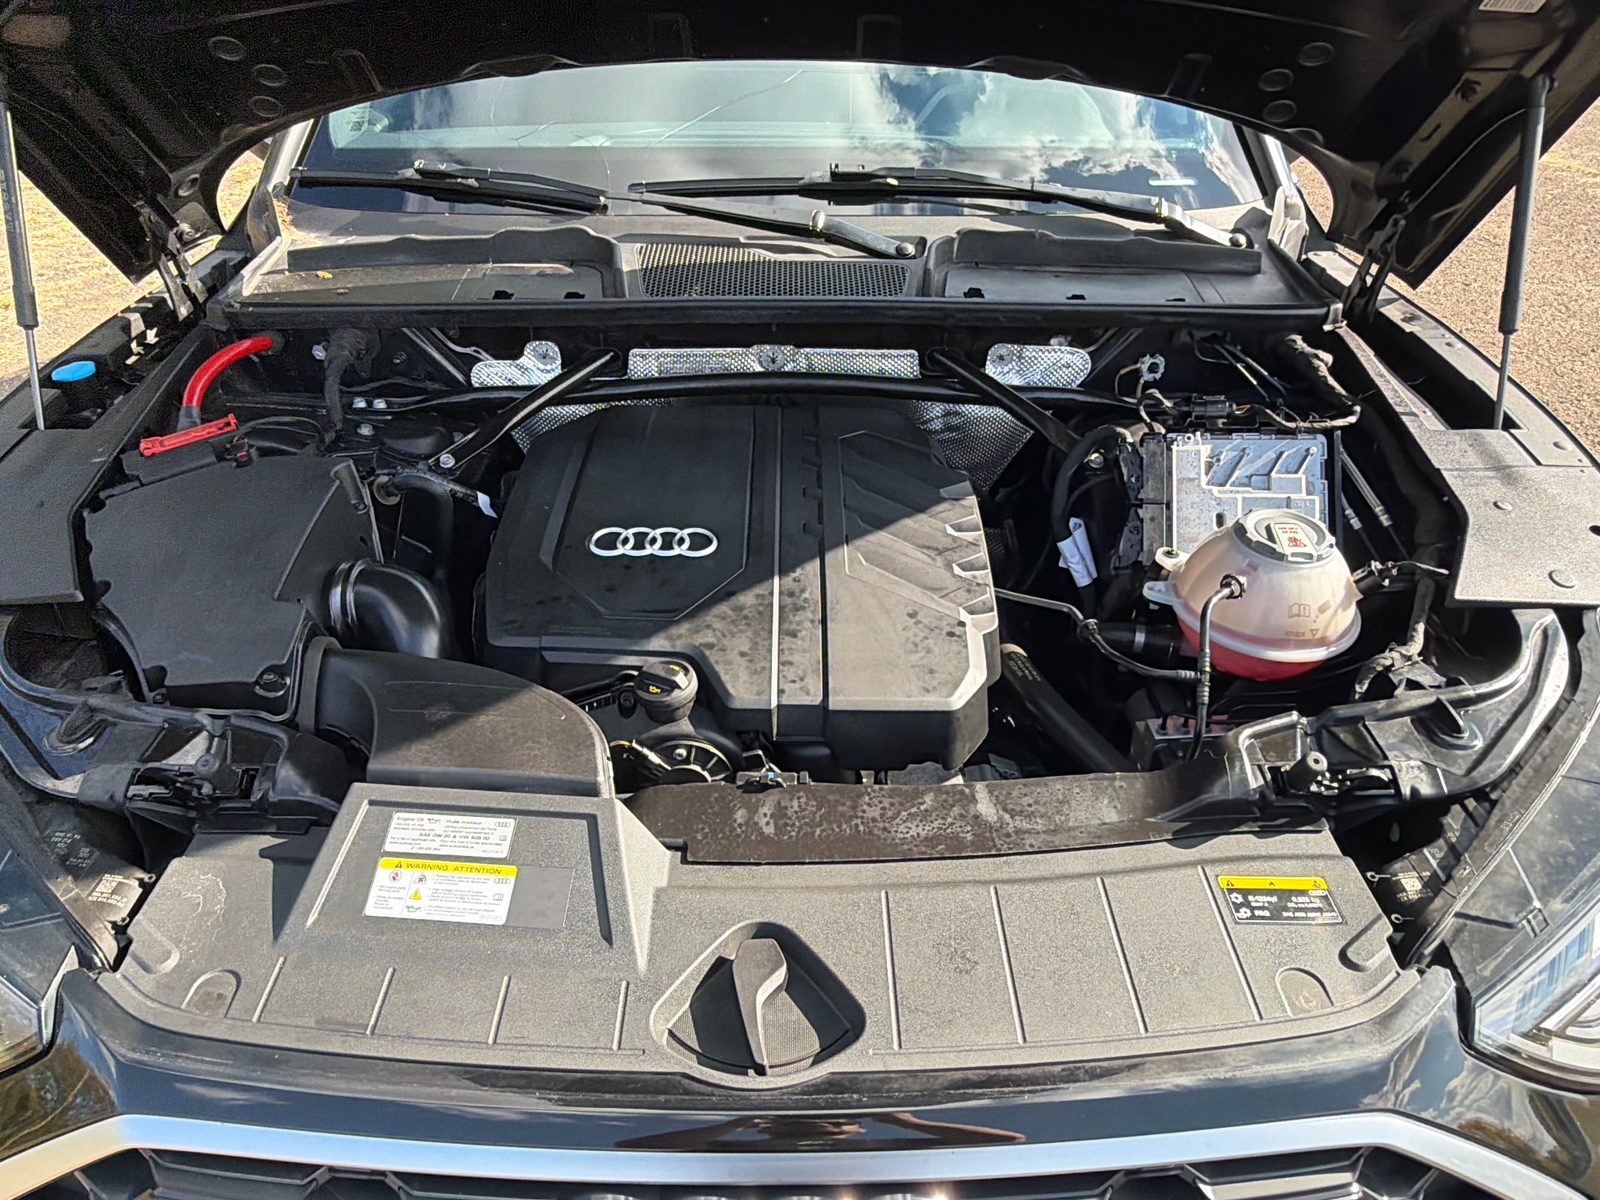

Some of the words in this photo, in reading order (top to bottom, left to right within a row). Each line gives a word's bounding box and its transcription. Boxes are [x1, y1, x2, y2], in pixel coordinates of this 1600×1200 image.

[1285, 630, 1306, 638] max
[405, 862, 448, 871] WARNING
[452, 865, 502, 874] ATTENTION
